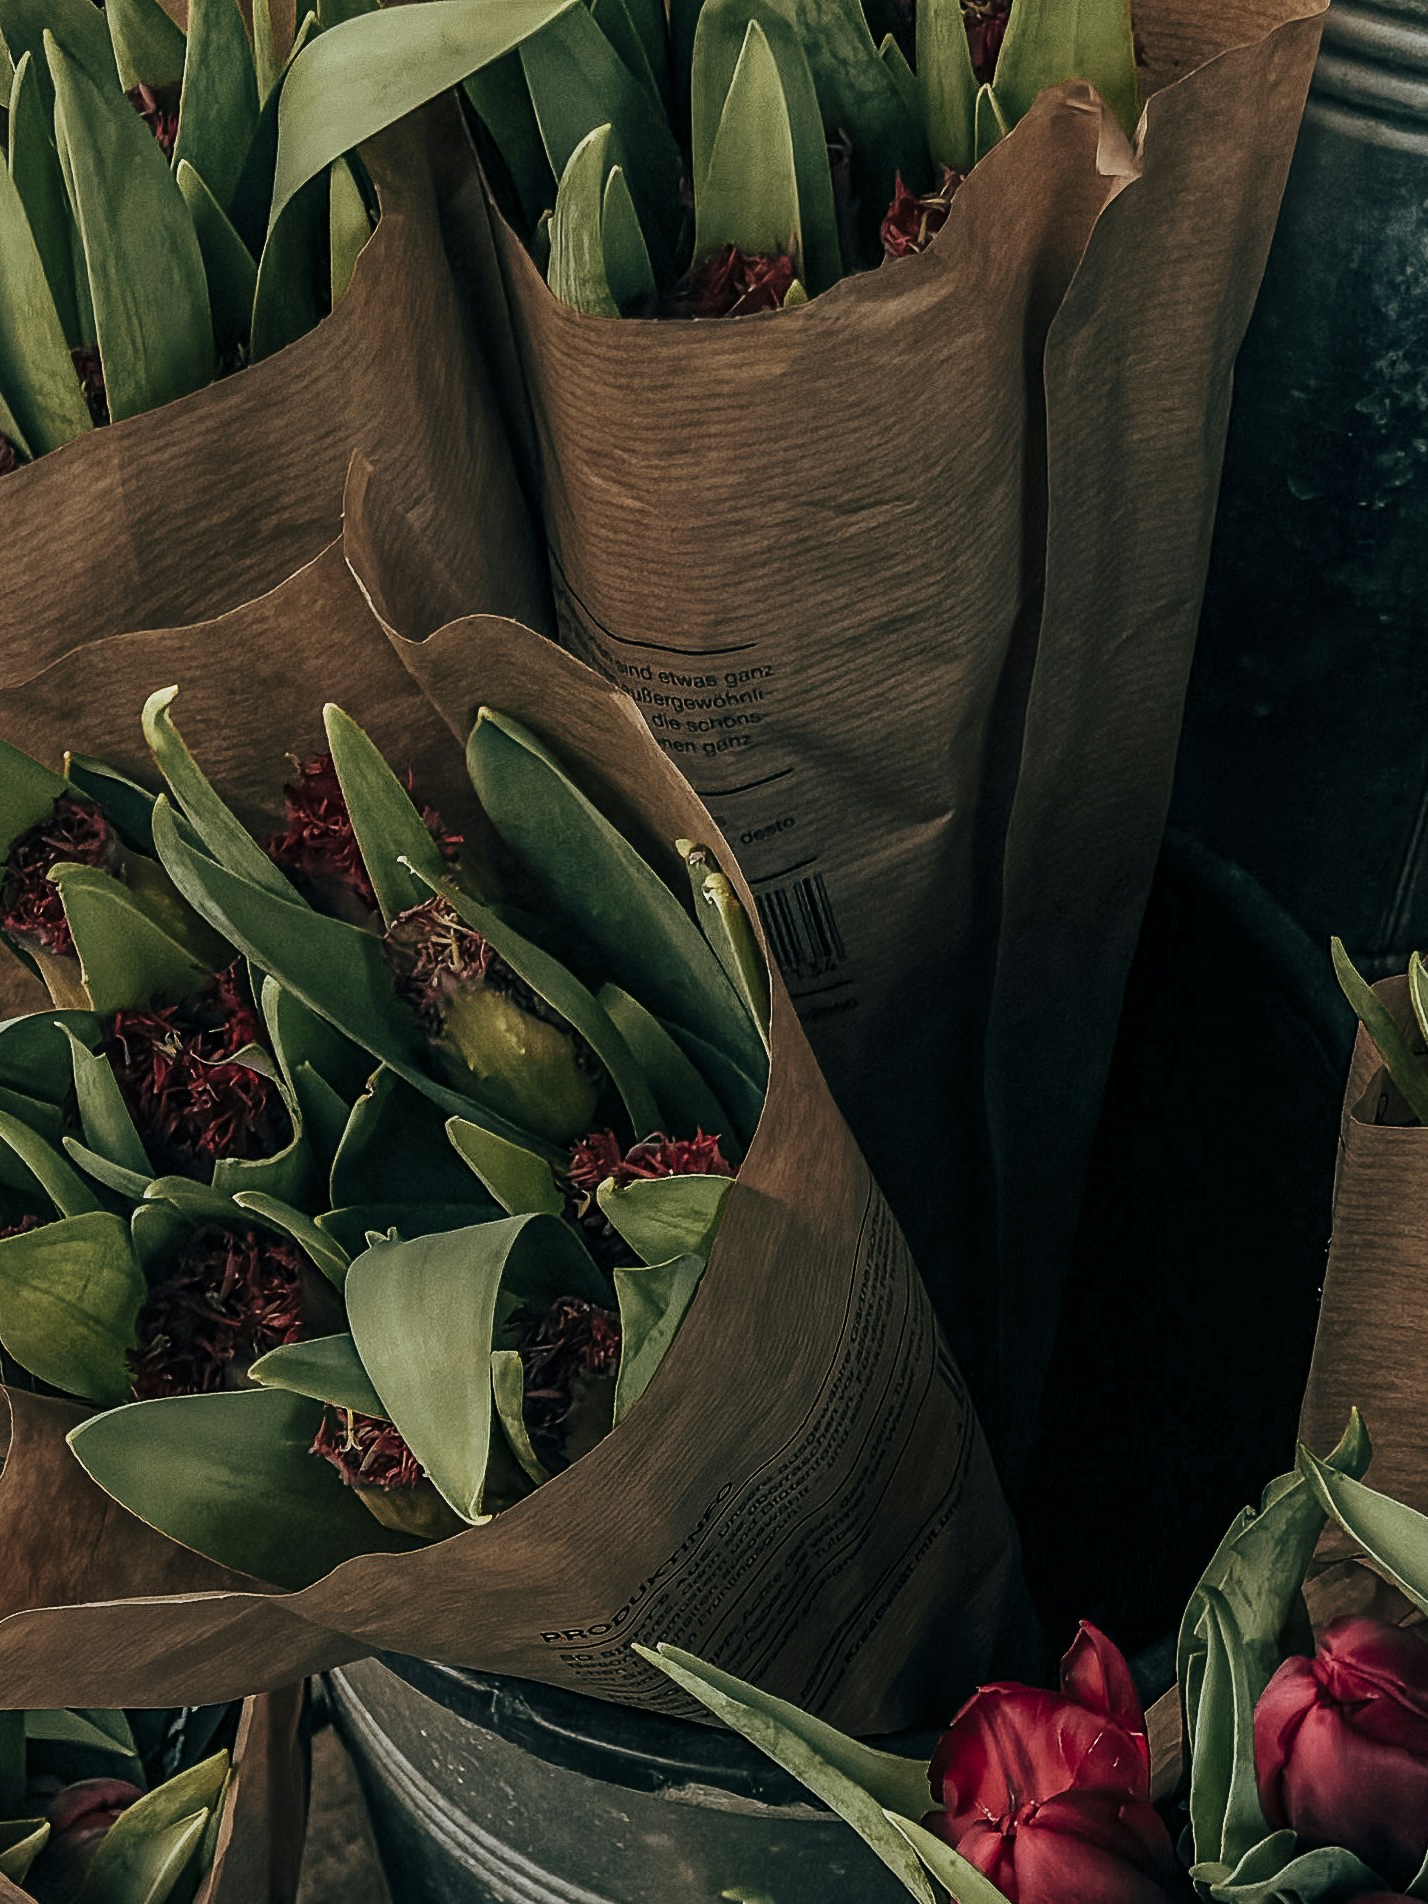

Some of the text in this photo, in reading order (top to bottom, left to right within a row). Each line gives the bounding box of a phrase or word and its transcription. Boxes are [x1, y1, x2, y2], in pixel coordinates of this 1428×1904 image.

[658, 670, 719, 688] etwas
[723, 663, 774, 688] ganz
[703, 733, 752, 757] ganz
[538, 1481, 733, 1643] PRODUKTINFO
